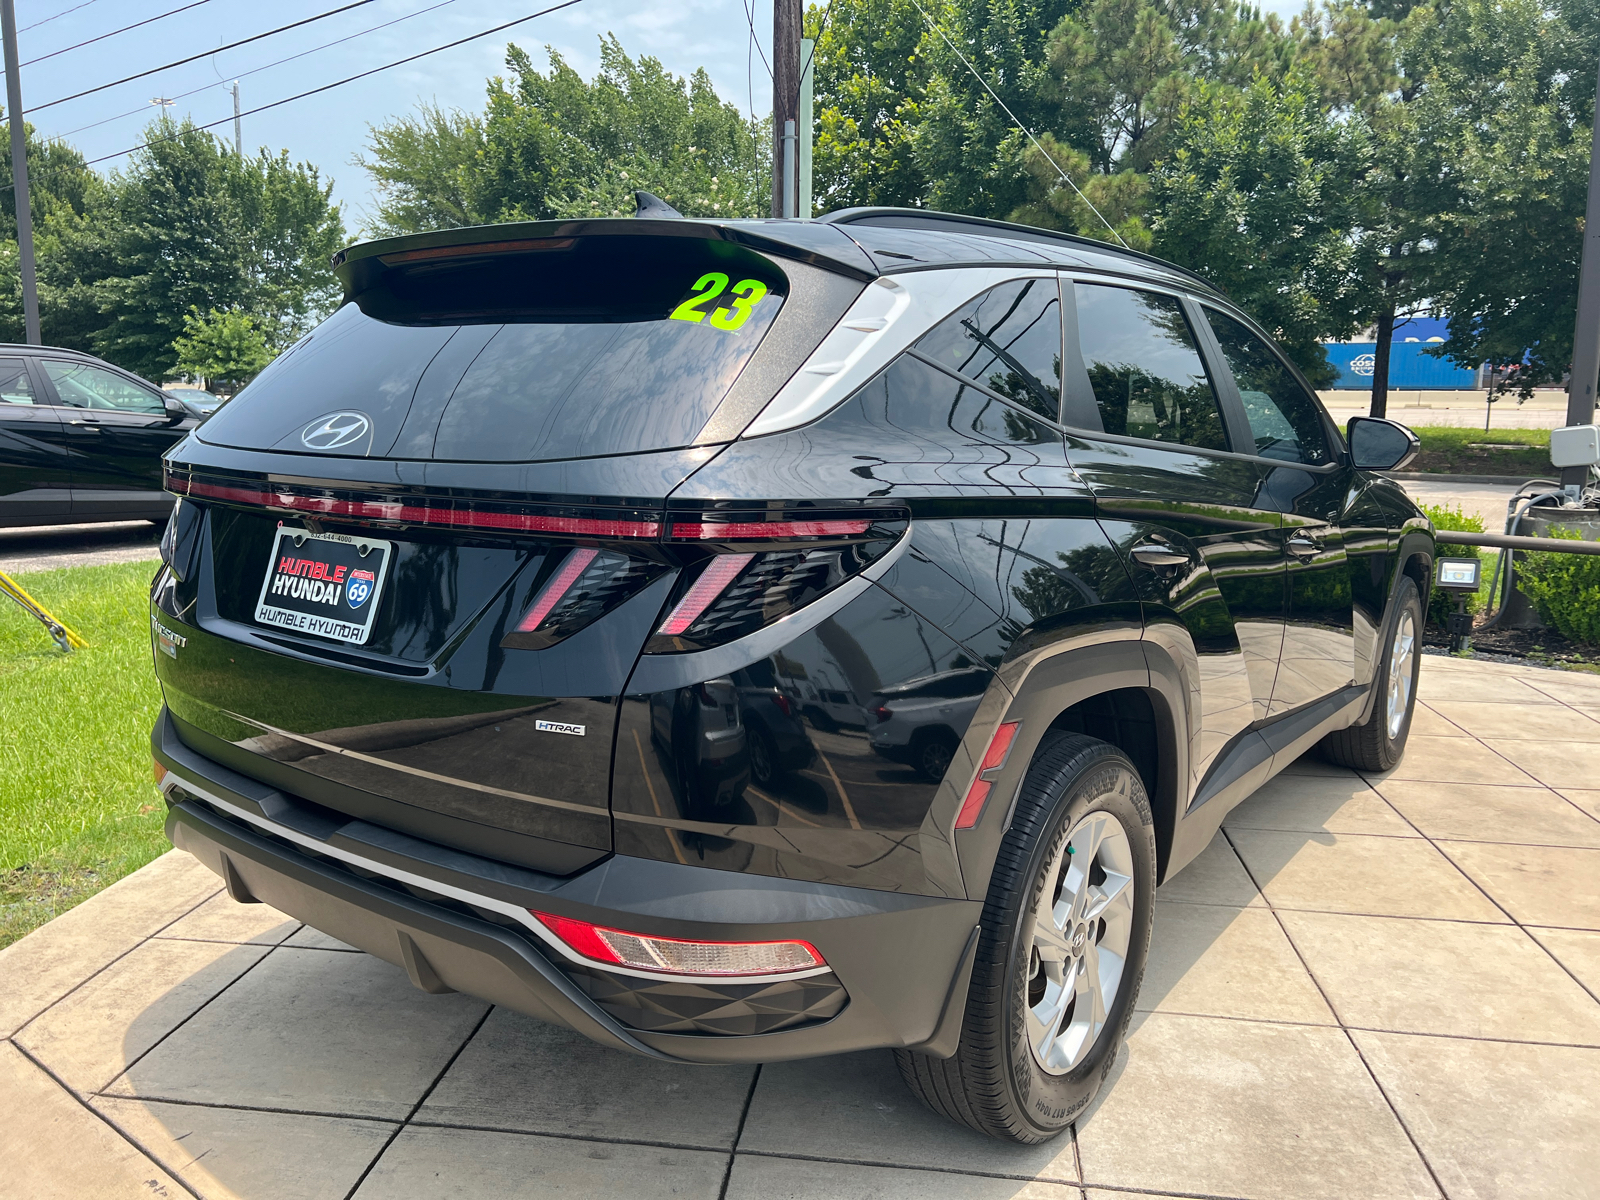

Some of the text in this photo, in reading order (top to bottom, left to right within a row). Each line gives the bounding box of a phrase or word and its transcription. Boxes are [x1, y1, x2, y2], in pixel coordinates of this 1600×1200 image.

[669, 272, 768, 331] 23
[278, 556, 347, 583] HUMBLE
[272, 574, 342, 606] HYUNDAI
[348, 583, 368, 602] 69
[259, 608, 364, 641] HUMBLE HYUNDAI
[539, 722, 581, 733] HTRAC
[1030, 814, 1072, 915] KUMHO
[1035, 1098, 1052, 1117] 104H
[1052, 1108, 1066, 1118] R17
